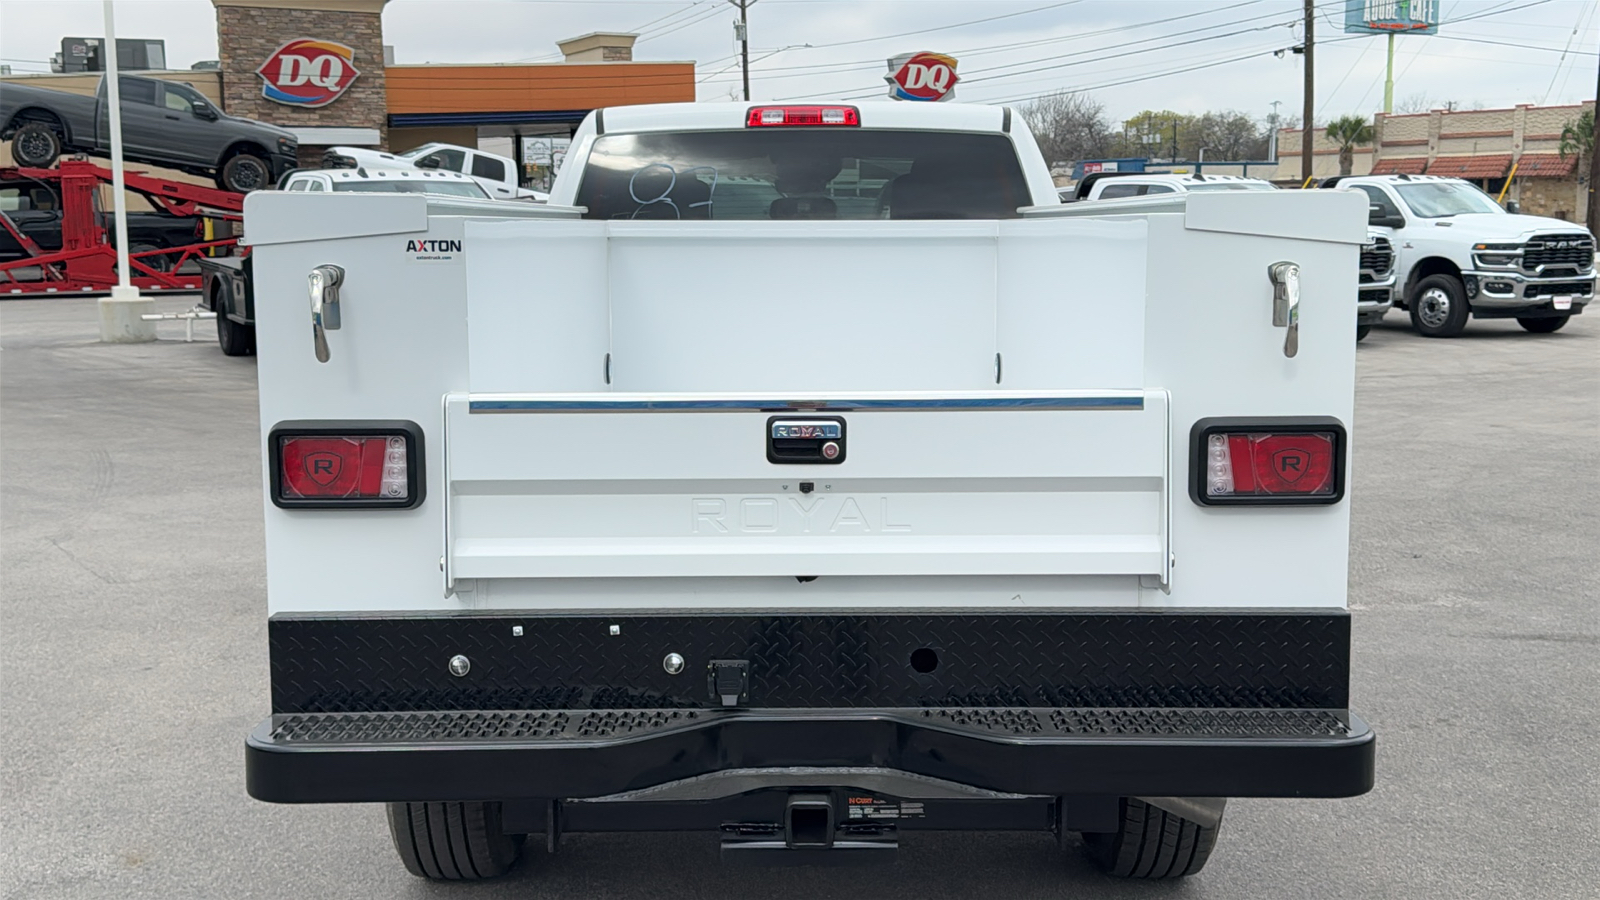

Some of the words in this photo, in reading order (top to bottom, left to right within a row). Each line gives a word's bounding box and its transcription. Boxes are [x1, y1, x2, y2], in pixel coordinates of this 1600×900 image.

[276, 54, 343, 92] DQ
[904, 64, 950, 93] DQ
[406, 239, 462, 252] AXTON
[777, 426, 836, 437] ROYAL
[314, 459, 333, 475] R
[1281, 456, 1301, 472] R
[692, 497, 912, 533] ROYAL
